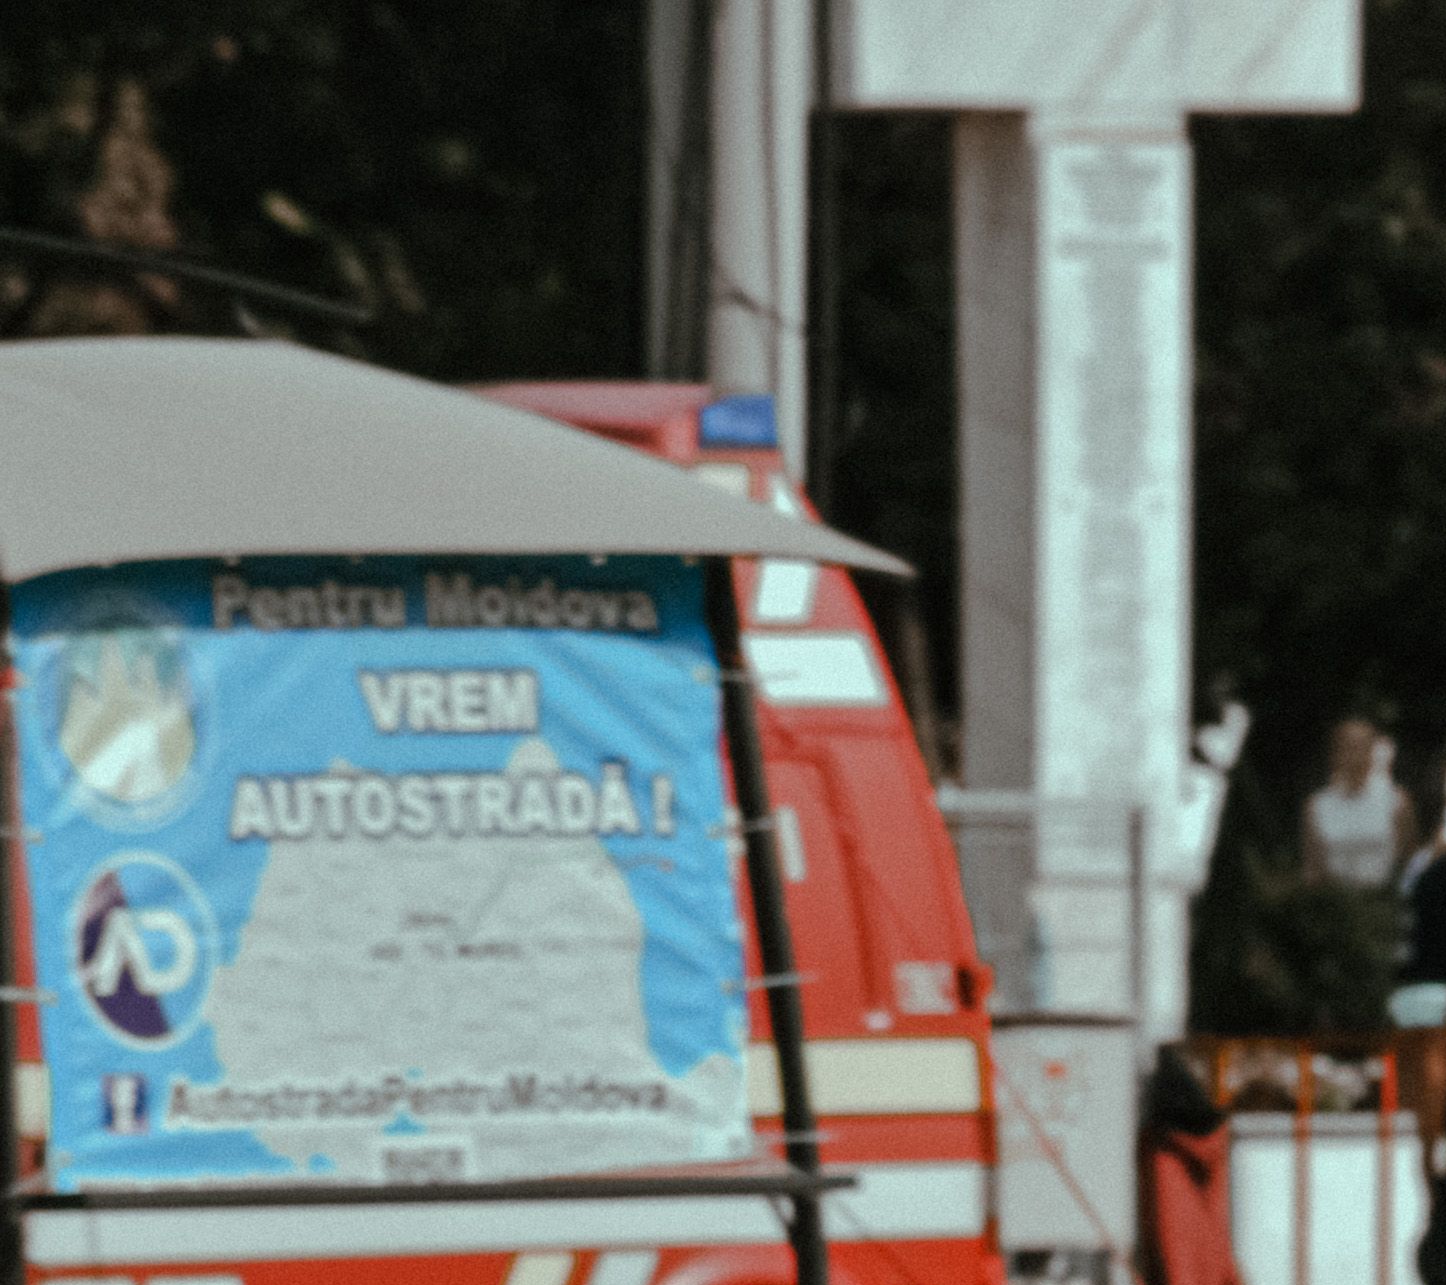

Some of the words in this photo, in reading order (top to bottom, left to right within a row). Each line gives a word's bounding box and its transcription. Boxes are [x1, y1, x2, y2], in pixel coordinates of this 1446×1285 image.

[213, 574, 406, 632] Pentru
[425, 573, 659, 635] Moldova
[358, 667, 540, 734] VREM
